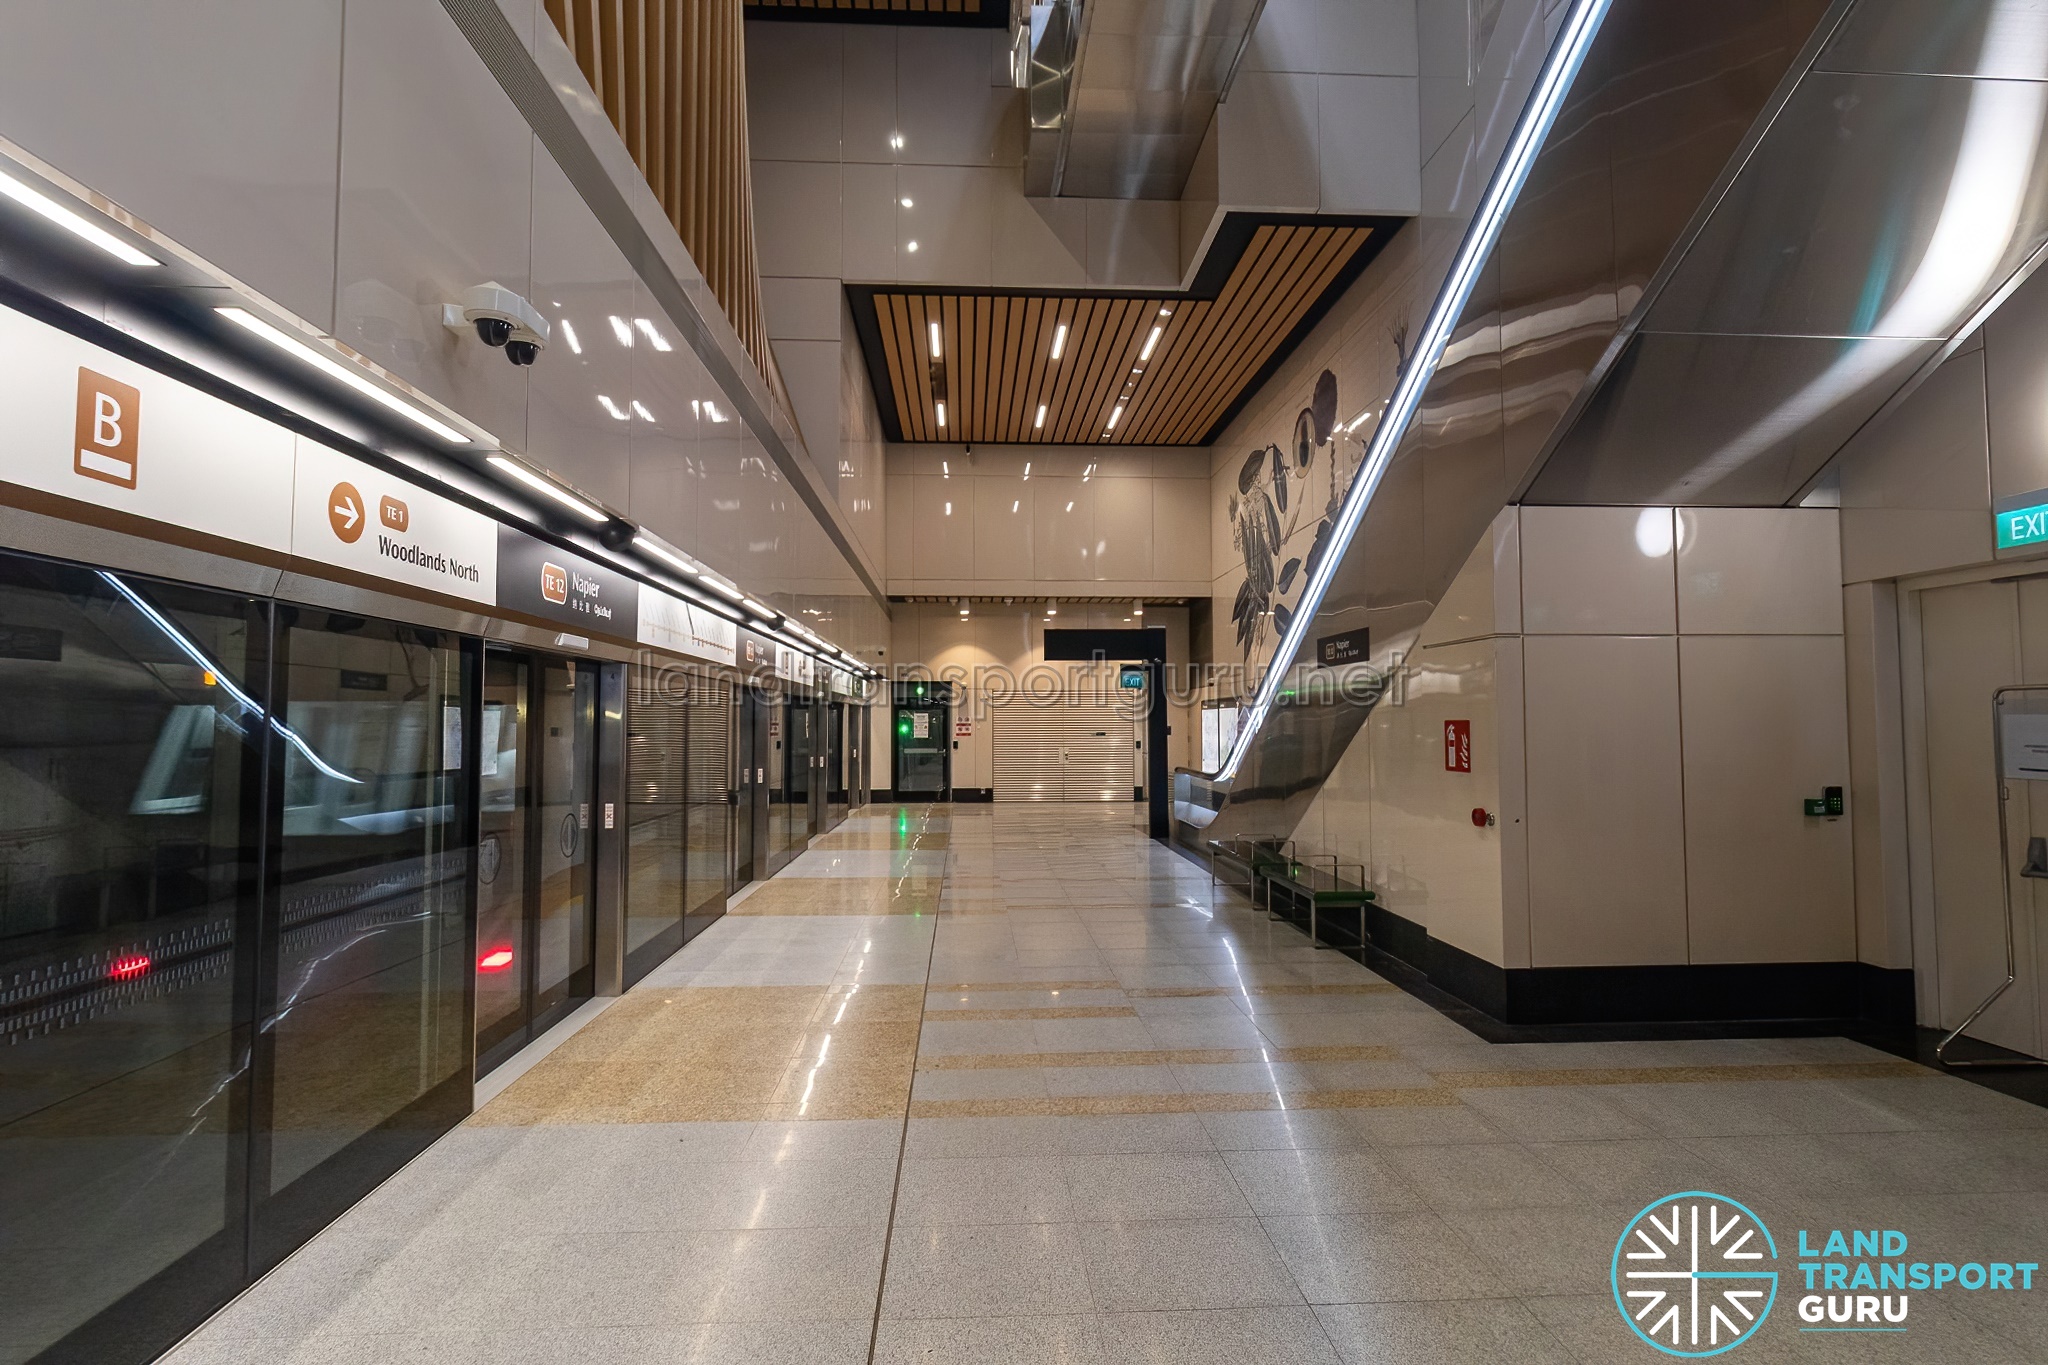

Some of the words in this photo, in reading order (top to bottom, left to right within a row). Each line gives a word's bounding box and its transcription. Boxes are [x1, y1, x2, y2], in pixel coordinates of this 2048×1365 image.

[93, 391, 122, 447] B
[386, 505, 398, 521] TE
[378, 534, 446, 574] Woodlands
[449, 558, 479, 583] North
[545, 573, 555, 591] TE
[572, 571, 600, 599] Napier
[1124, 677, 1140, 687] EXIT
